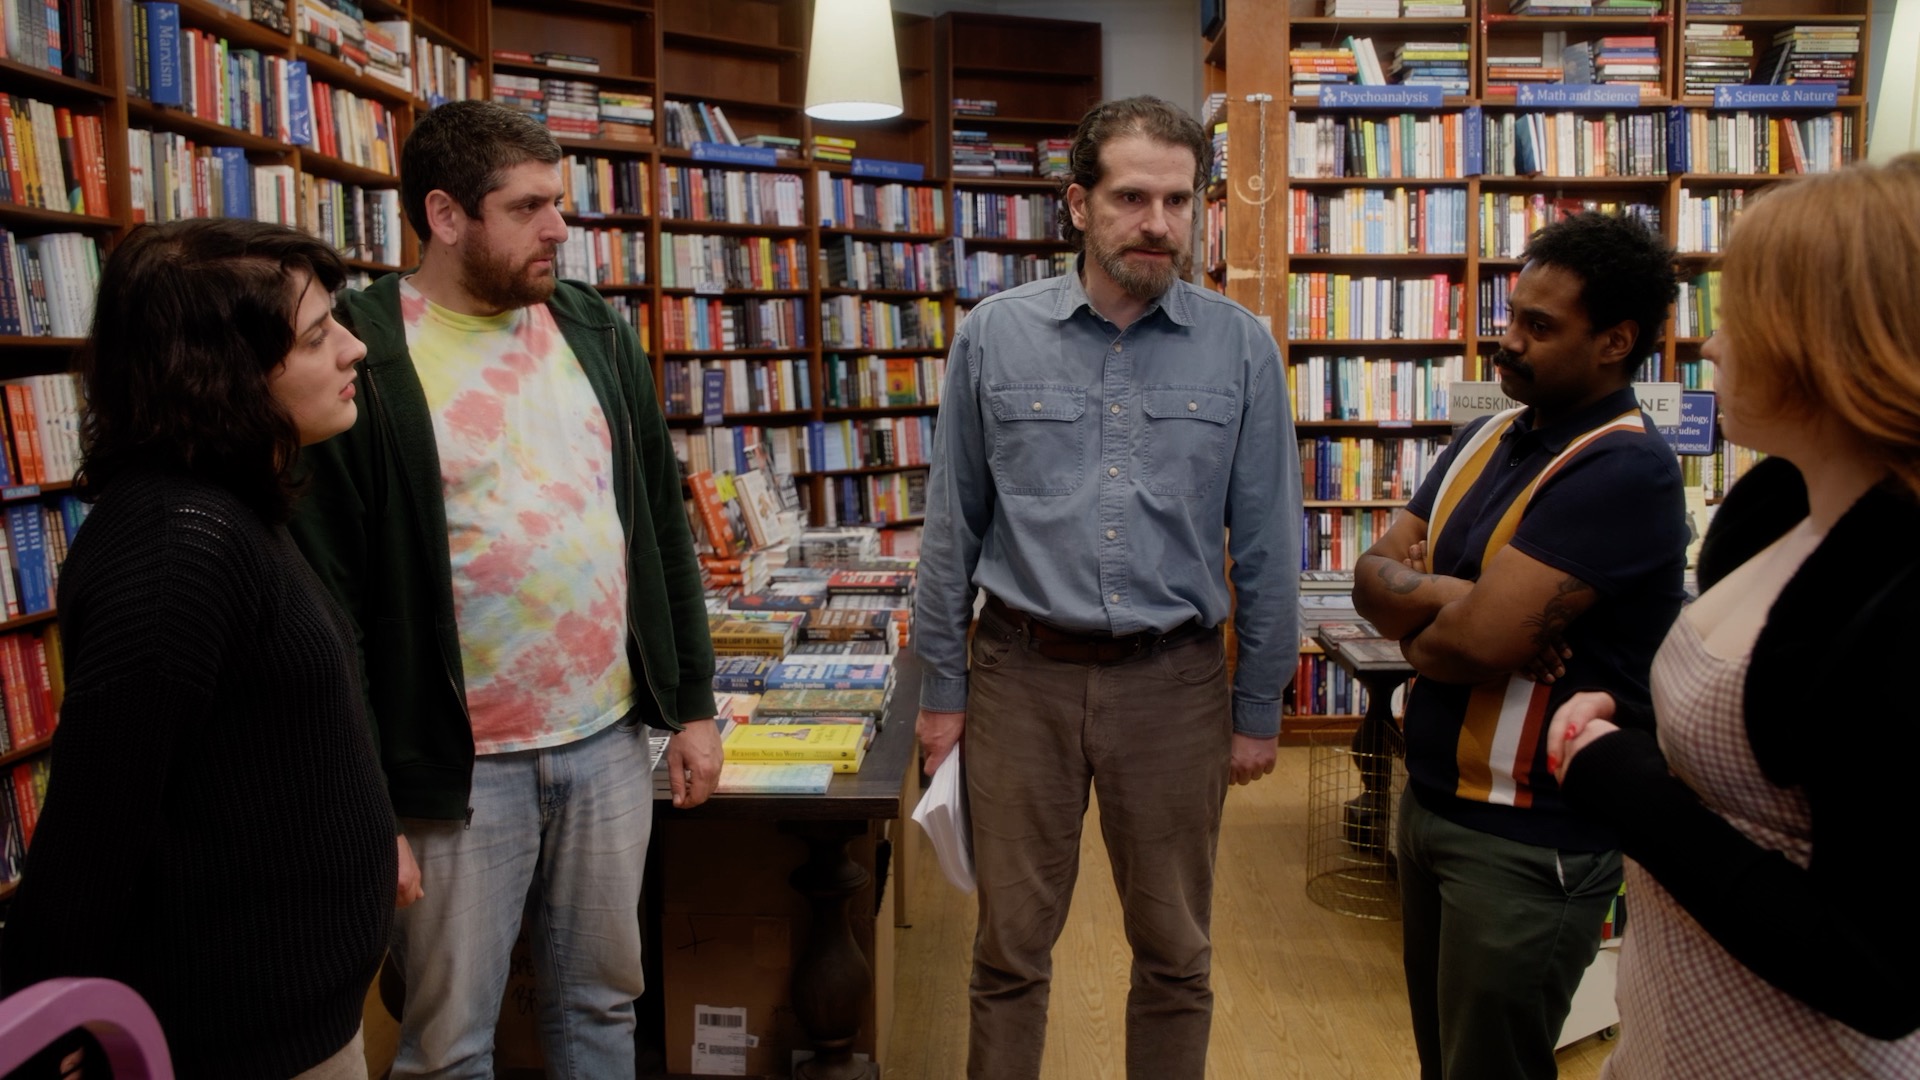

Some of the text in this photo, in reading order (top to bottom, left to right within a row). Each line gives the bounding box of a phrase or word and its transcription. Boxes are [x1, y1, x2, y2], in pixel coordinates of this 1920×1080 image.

[159, 25, 174, 88] Marxism
[1340, 91, 1428, 104] Psychoanalysis
[1537, 89, 1637, 102] Math and Science
[1735, 90, 1835, 102] Science & Nature
[5, 117, 20, 172] SPIN DICTATORS
[1468, 122, 1477, 158] Science
[865, 164, 898, 175] New York
[226, 164, 239, 215] Linguistics
[1640, 398, 1669, 412] NE
[1681, 414, 1709, 424] hology,
[1671, 427, 1700, 435] Sudies
[12, 513, 28, 552] BIBI
[27, 512, 41, 549] BIBI
[784, 750, 804, 758] Worry
